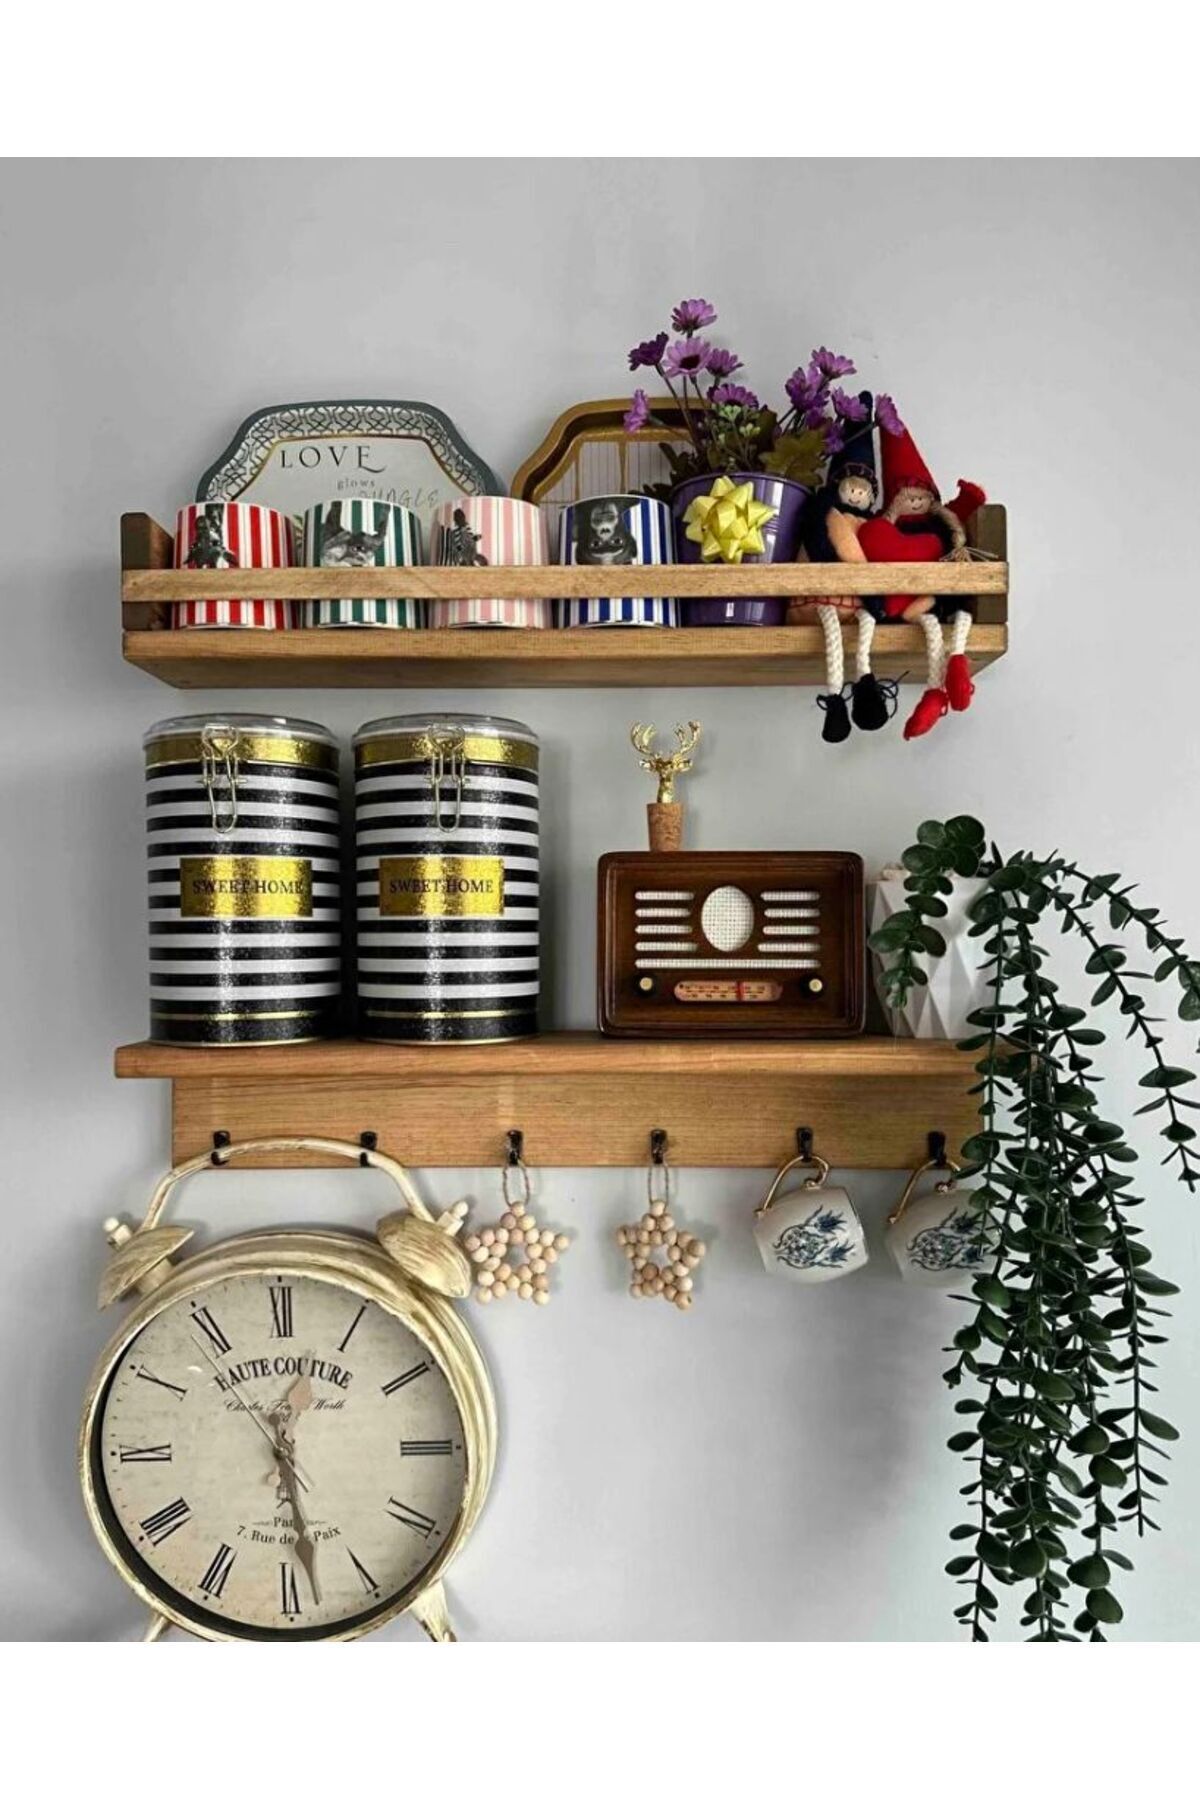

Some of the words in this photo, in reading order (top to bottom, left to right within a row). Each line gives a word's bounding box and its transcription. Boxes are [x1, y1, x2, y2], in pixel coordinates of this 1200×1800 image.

[281, 446, 387, 473] LOVE
[337, 477, 376, 491] glows
[192, 879, 252, 894] SWEET
[255, 879, 303, 894] HOME
[390, 878, 442, 893] SWEET
[446, 878, 494, 893] HOME
[269, 1286, 293, 1338] XII
[190, 1306, 233, 1359] XI
[337, 1305, 366, 1352] I
[135, 1364, 188, 1401] X
[214, 1358, 272, 1392] HAUTE
[273, 1357, 353, 1389] COUTURE
[381, 1361, 430, 1396] II
[400, 1439, 452, 1457] III
[251, 1529, 276, 1543] Rue
[279, 1533, 295, 1545] de
[313, 1526, 341, 1542] Paix
